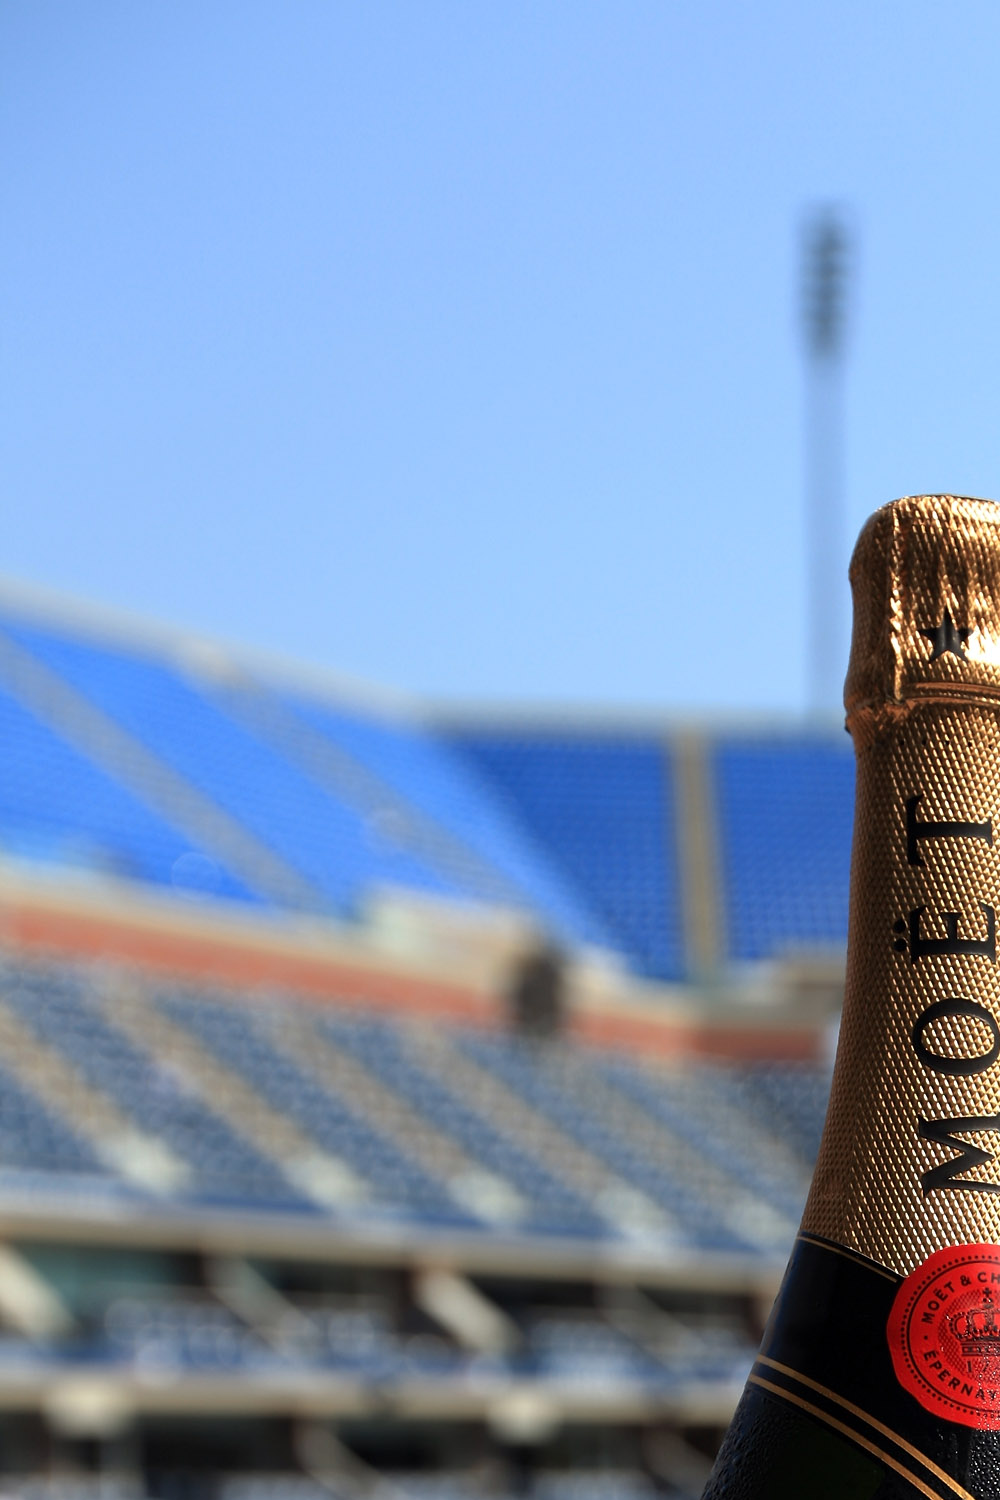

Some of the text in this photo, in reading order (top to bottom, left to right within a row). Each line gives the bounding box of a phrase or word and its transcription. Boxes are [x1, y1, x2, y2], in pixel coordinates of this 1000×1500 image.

[922, 1281, 956, 1325] MOËT
[959, 1274, 973, 1287] &
[923, 1350, 997, 1402] ÉPERNAY
